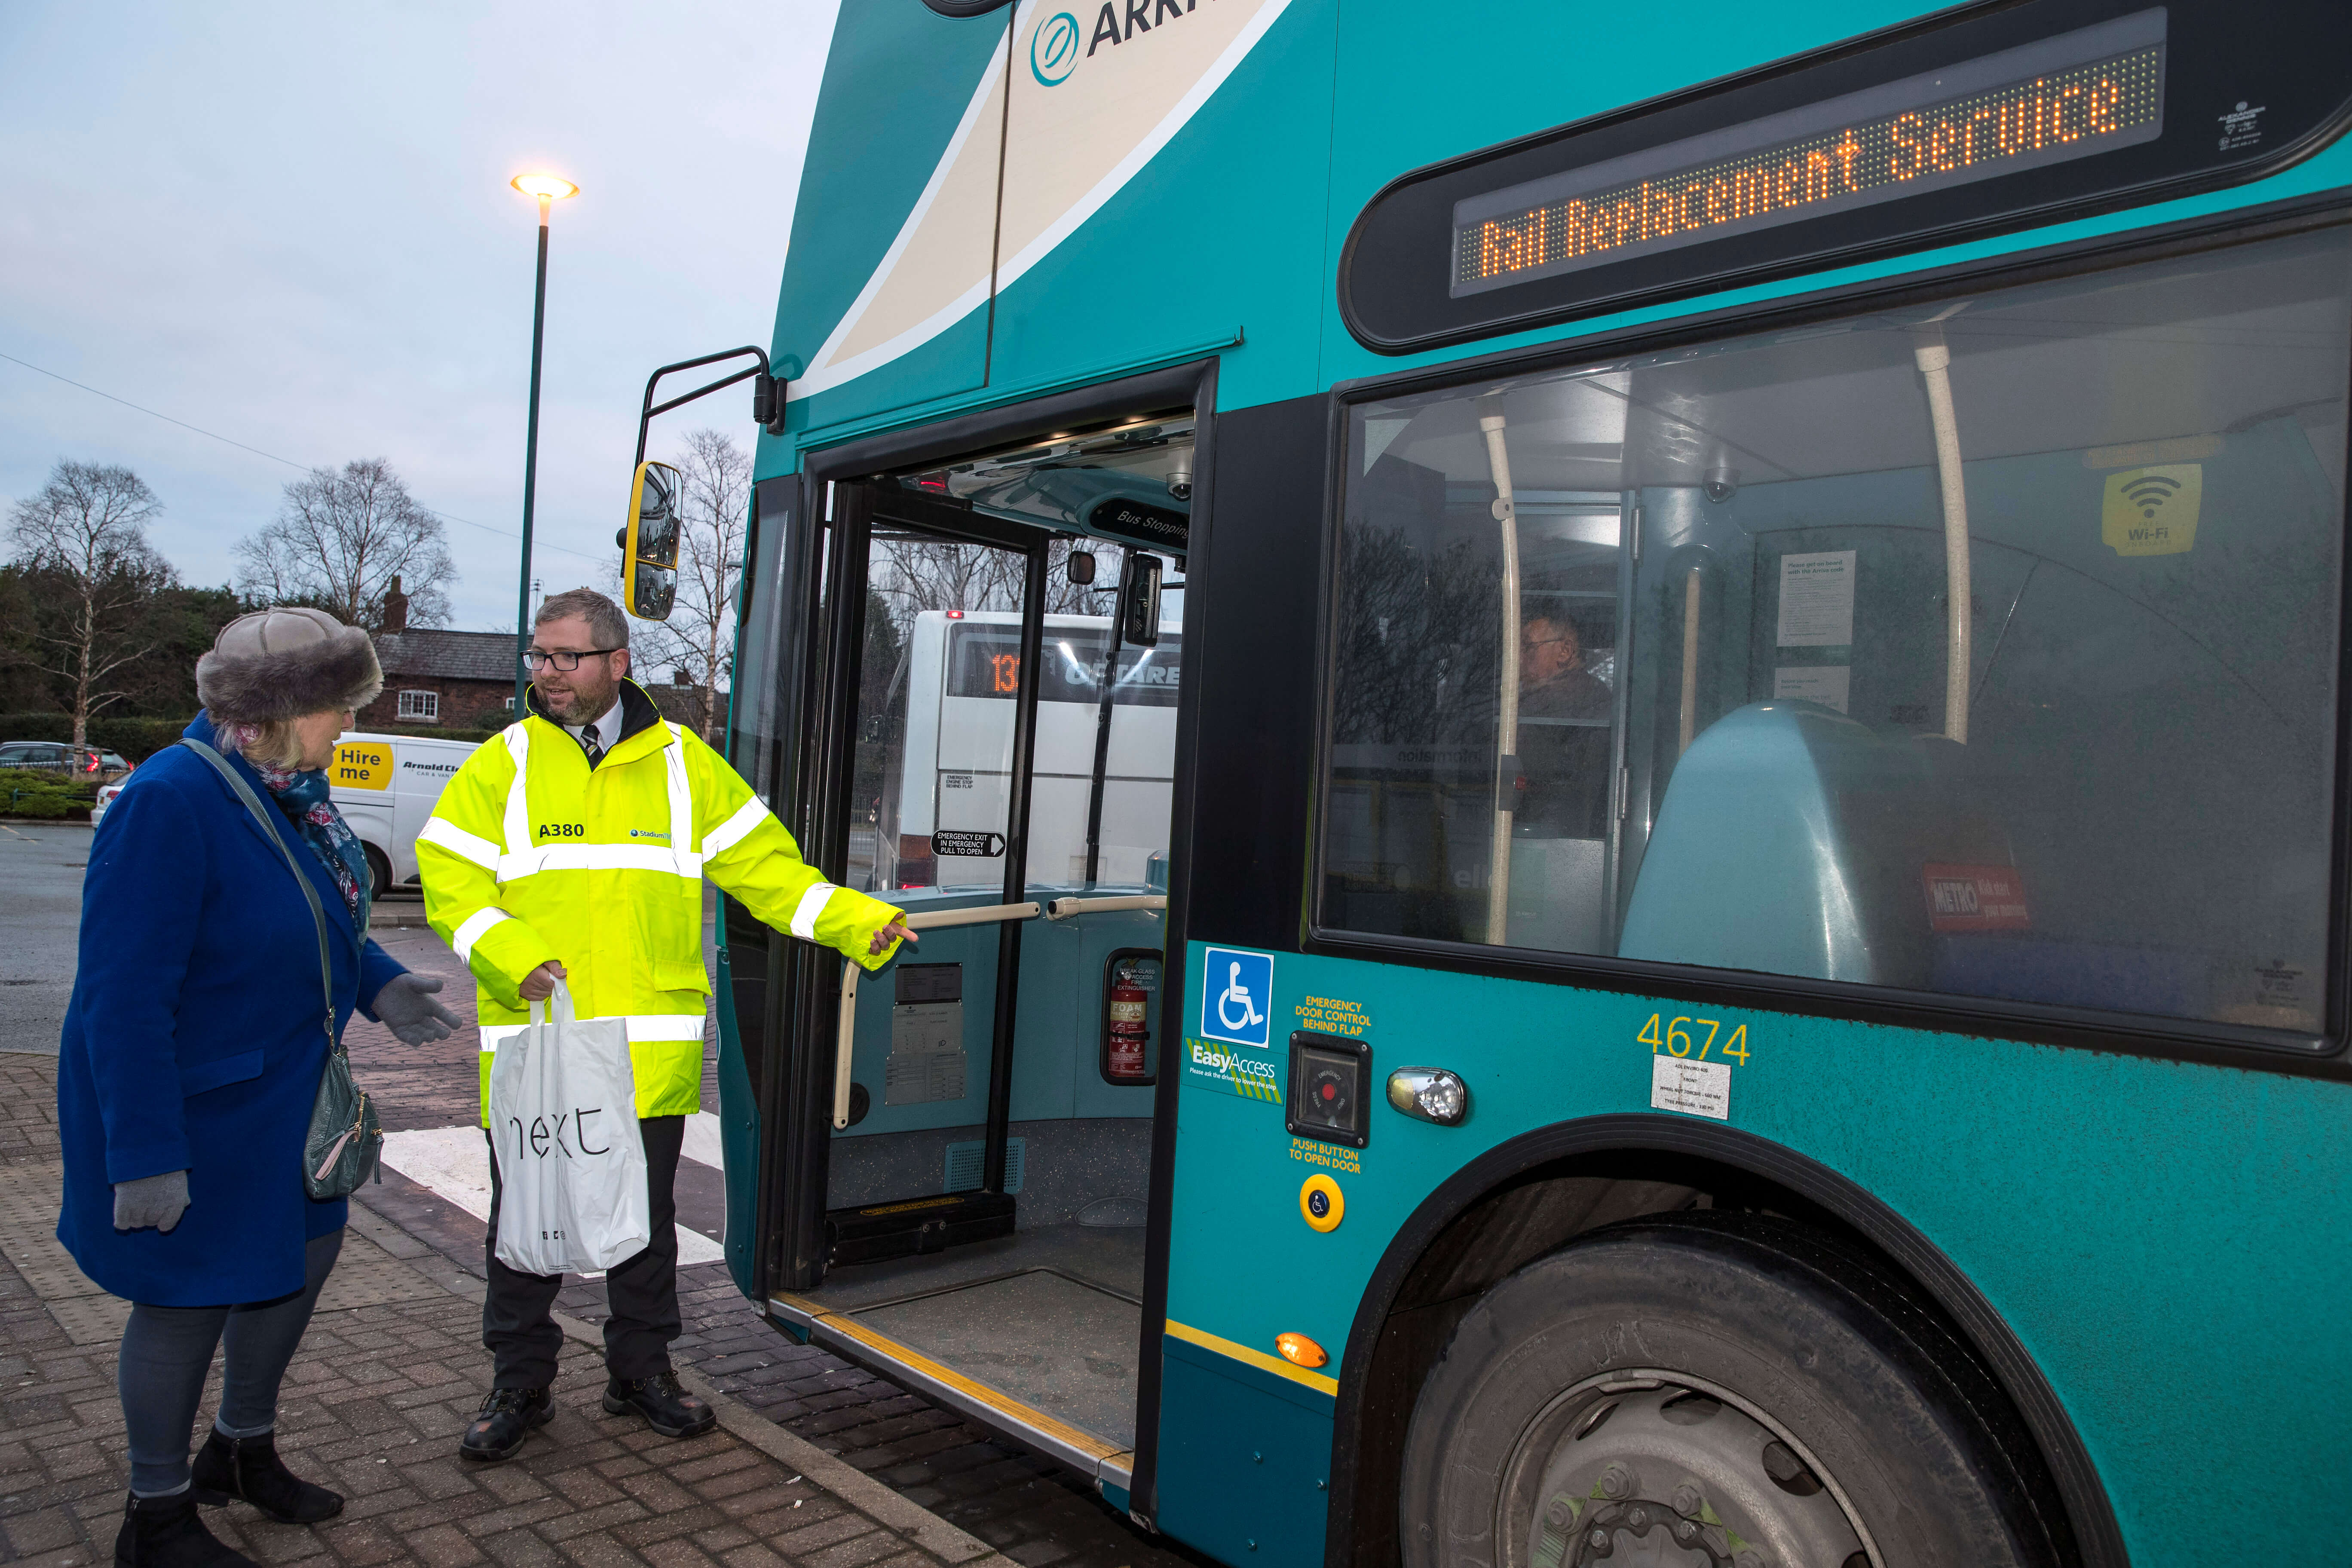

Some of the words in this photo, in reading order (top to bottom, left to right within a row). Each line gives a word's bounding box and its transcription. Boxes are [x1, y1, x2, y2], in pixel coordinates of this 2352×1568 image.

[1087, 0, 1216, 58] ARR
[1482, 207, 1546, 278] Rail
[1568, 130, 1859, 257] Replacement
[1891, 79, 2118, 180] Service
[1118, 511, 1141, 524] Bus
[1142, 517, 1189, 539] Stopping
[2128, 527, 2168, 540] Wi-Fi
[992, 654, 1020, 692] 13
[341, 749, 381, 766] Hire
[403, 761, 444, 771] Arnold
[340, 767, 370, 781] me
[539, 824, 584, 838] A380
[949, 840, 984, 848] EMERGENCY
[1931, 882, 1978, 912] METRO
[1113, 1003, 1142, 1012] FOAM
[1306, 995, 1362, 1013] EMERGENCY
[1295, 1005, 1323, 1019] DOOR
[1325, 1010, 1371, 1026] CONTROL
[1303, 1018, 1337, 1033] BEHIND
[1339, 1024, 1362, 1036] FLAP
[1637, 1013, 1751, 1066] 4674
[1189, 1067, 1204, 1075] Please
[1222, 1073, 1235, 1082] driver
[1242, 1078, 1256, 1087] lower
[1266, 1082, 1277, 1091] step
[1318, 1070, 1341, 1081] EMERGENCY
[1312, 1091, 1321, 1108] PRESS
[510, 1108, 610, 1160] next
[1293, 1138, 1317, 1152] PUSH
[1319, 1144, 1359, 1161] BUTTON
[1289, 1148, 1302, 1160] TO
[1305, 1152, 1330, 1167] OPEN
[1332, 1158, 1361, 1174] DOOR
